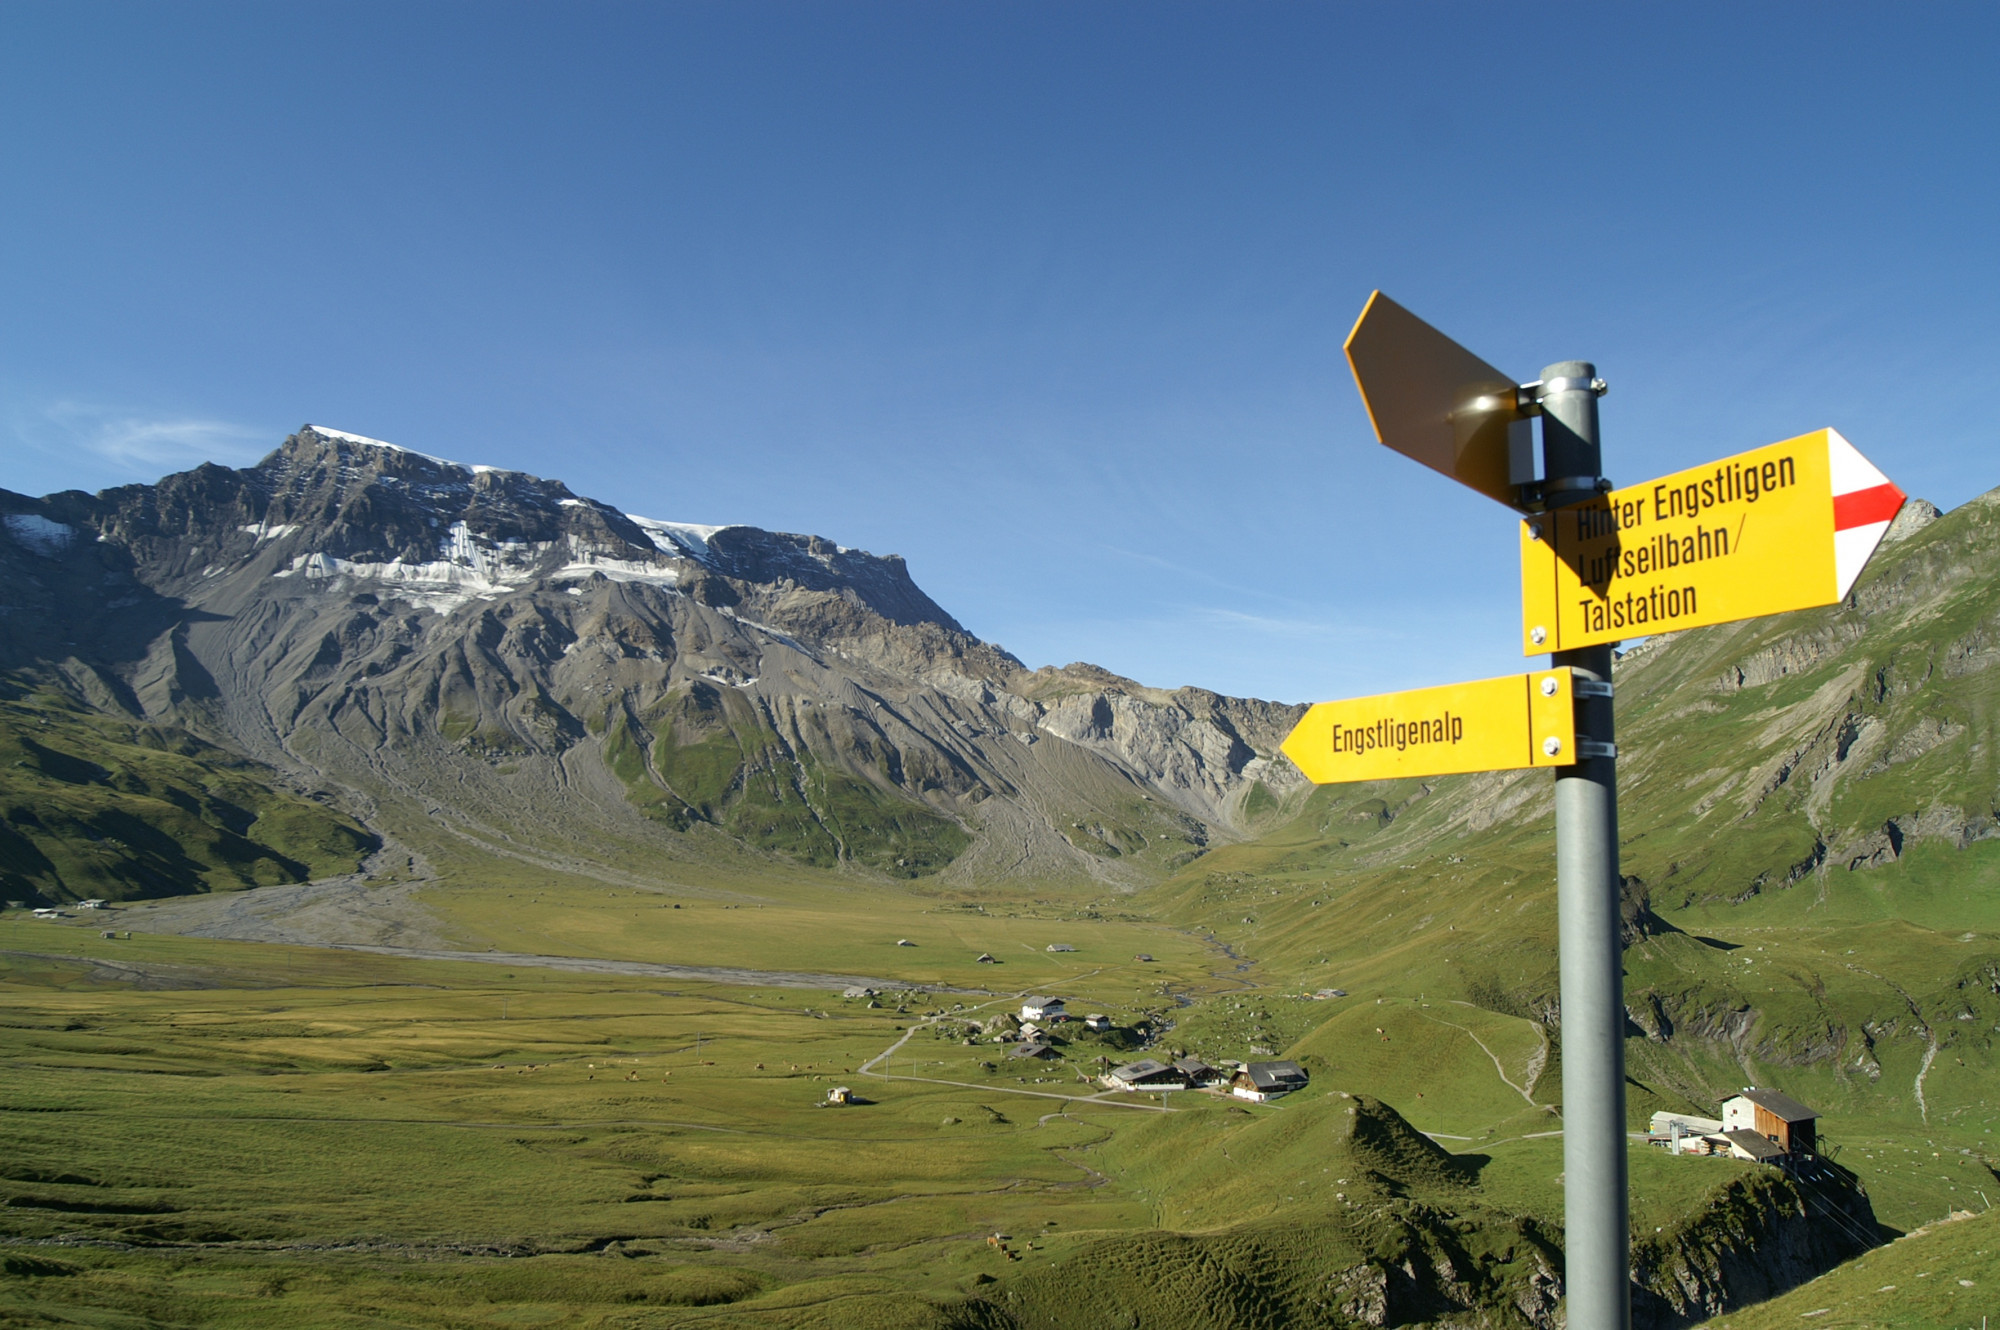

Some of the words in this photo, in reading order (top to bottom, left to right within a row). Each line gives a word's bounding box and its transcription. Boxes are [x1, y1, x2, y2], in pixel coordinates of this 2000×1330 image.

[1578, 496, 1644, 541] Hinter
[1654, 456, 1796, 521] Engstligen
[1579, 585, 1697, 634] Talstation
[1332, 711, 1463, 755] Engstligenalp
